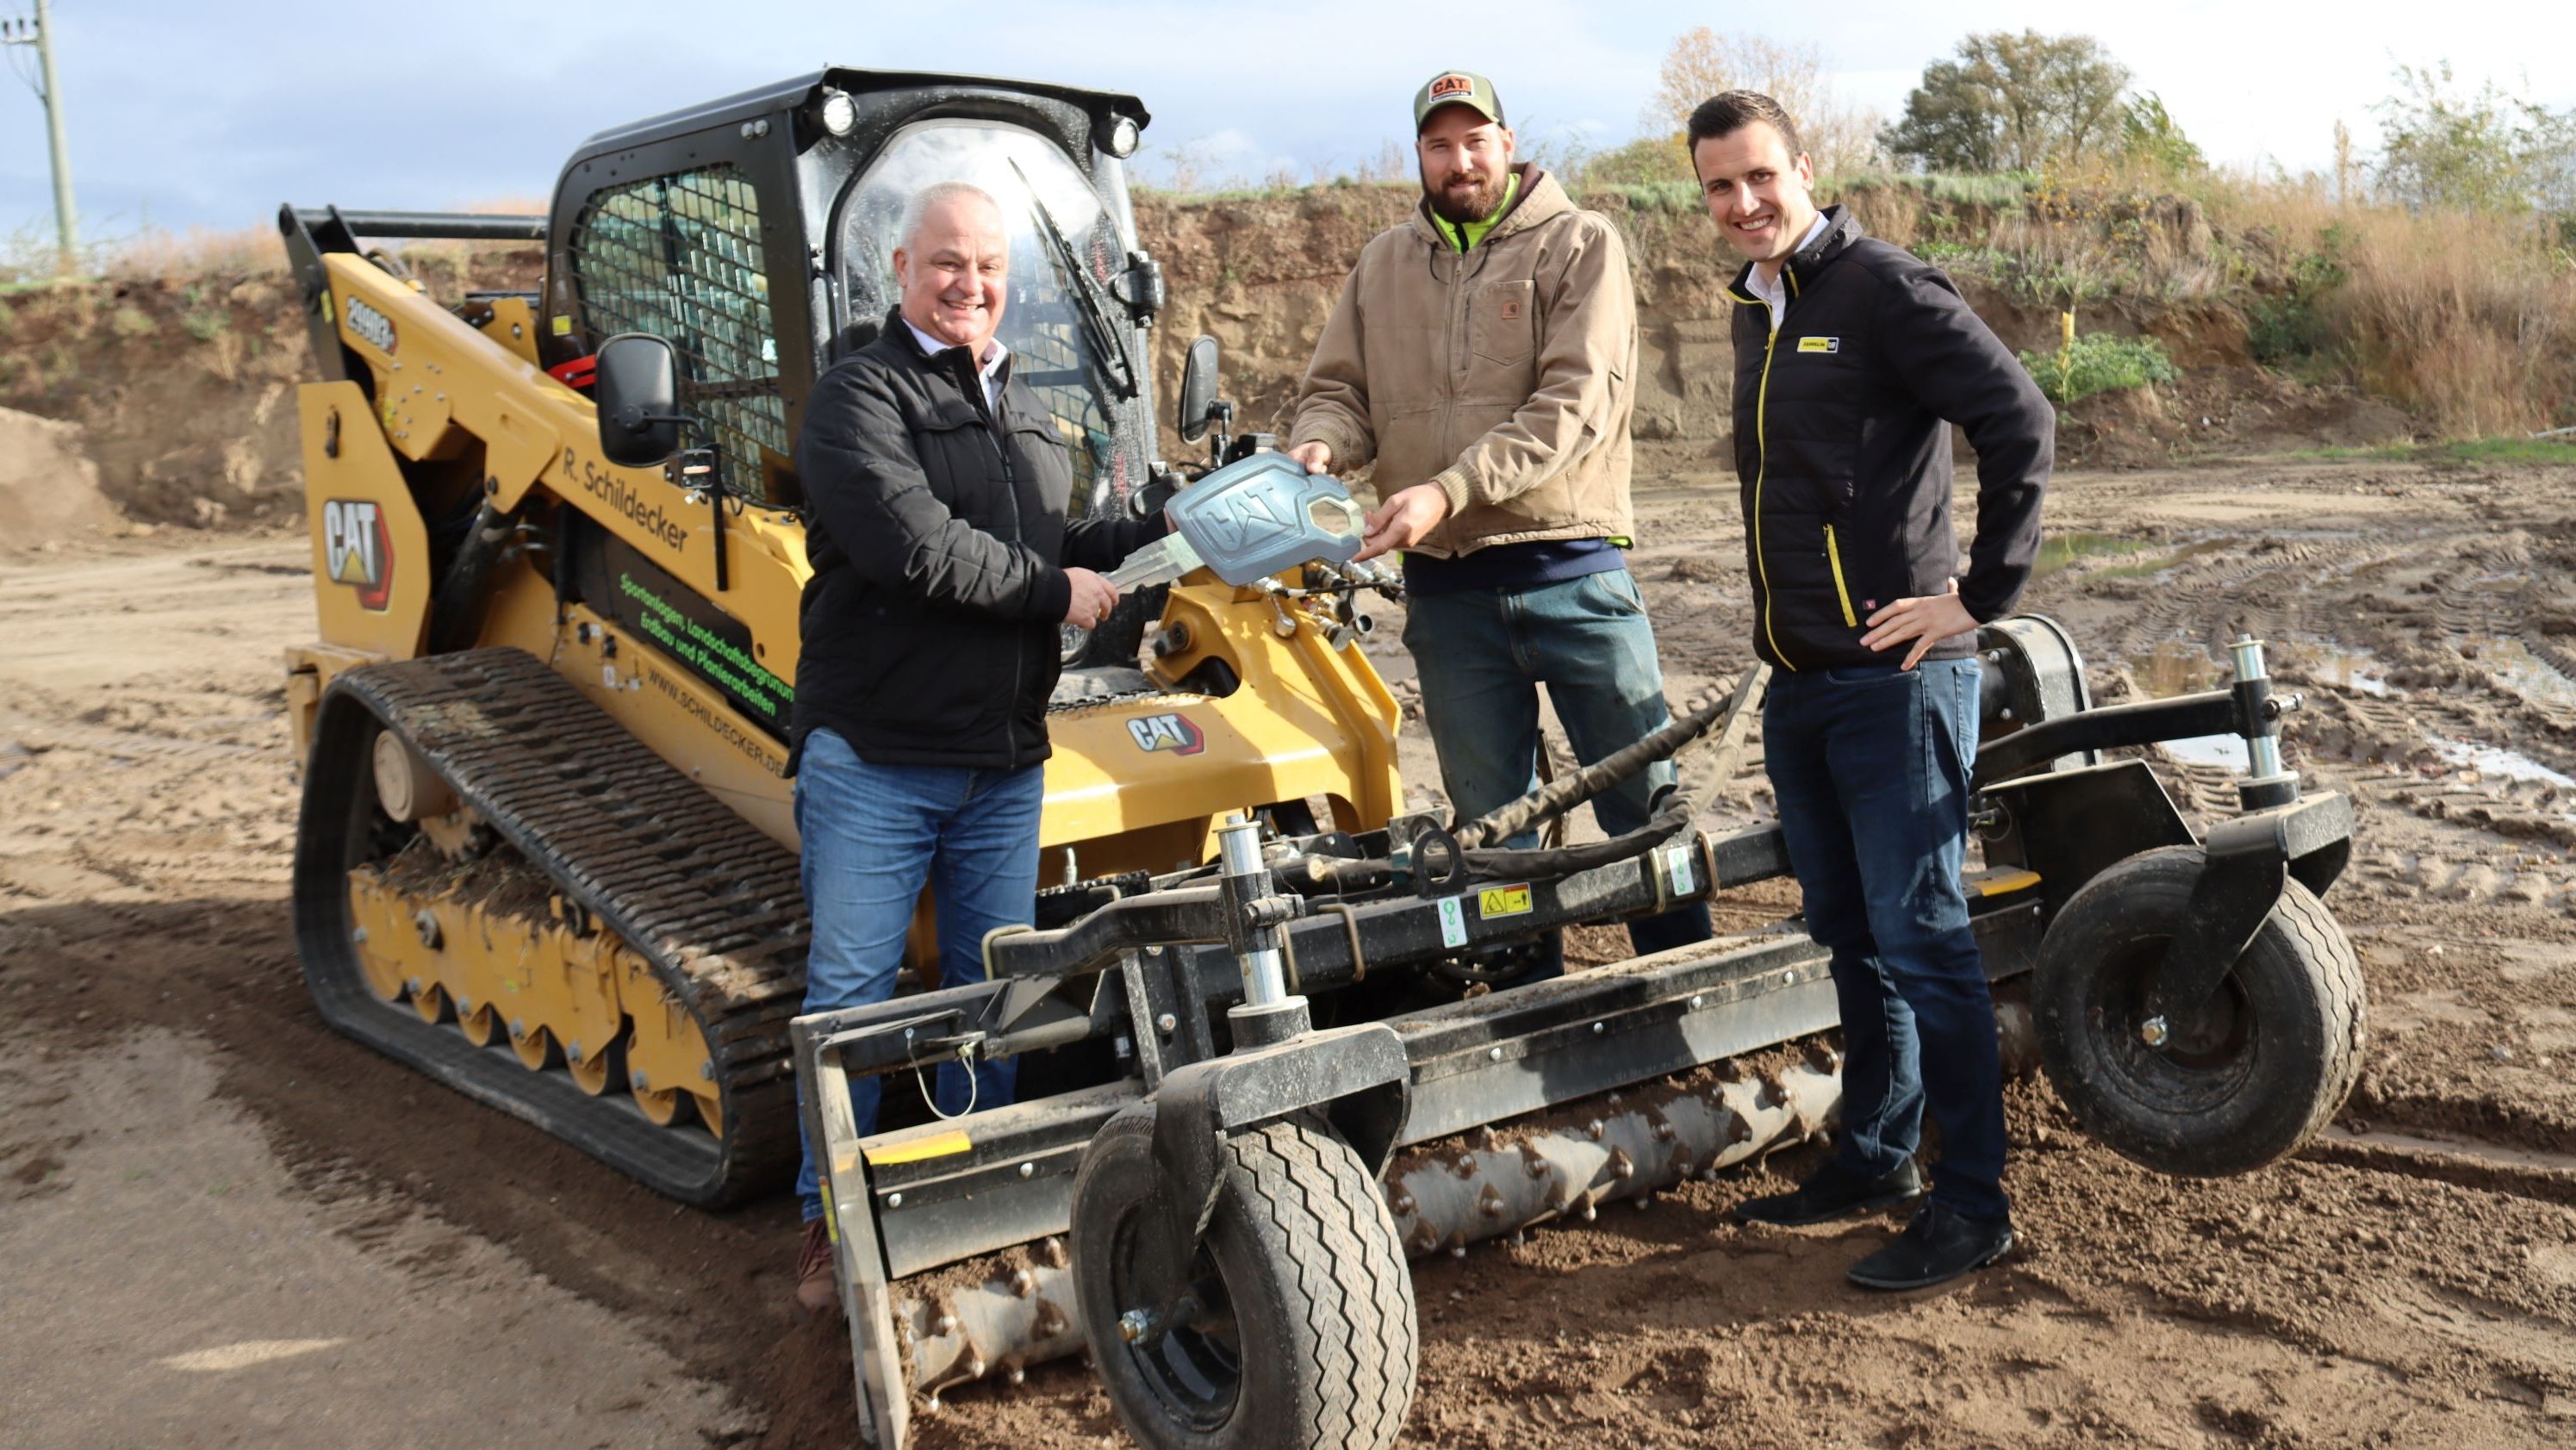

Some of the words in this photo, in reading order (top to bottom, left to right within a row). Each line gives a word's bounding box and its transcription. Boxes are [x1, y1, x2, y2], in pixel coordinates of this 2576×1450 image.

[1433, 78, 1466, 94] CAT
[563, 446, 578, 483] R.
[583, 460, 688, 552] Schildecker
[1192, 479, 1297, 553] CAT
[323, 499, 377, 585] CAT
[640, 611, 675, 646] Erdbau
[675, 636, 696, 662] und
[696, 648, 776, 716] Planierarbeiten
[1126, 713, 1189, 752] CAT
